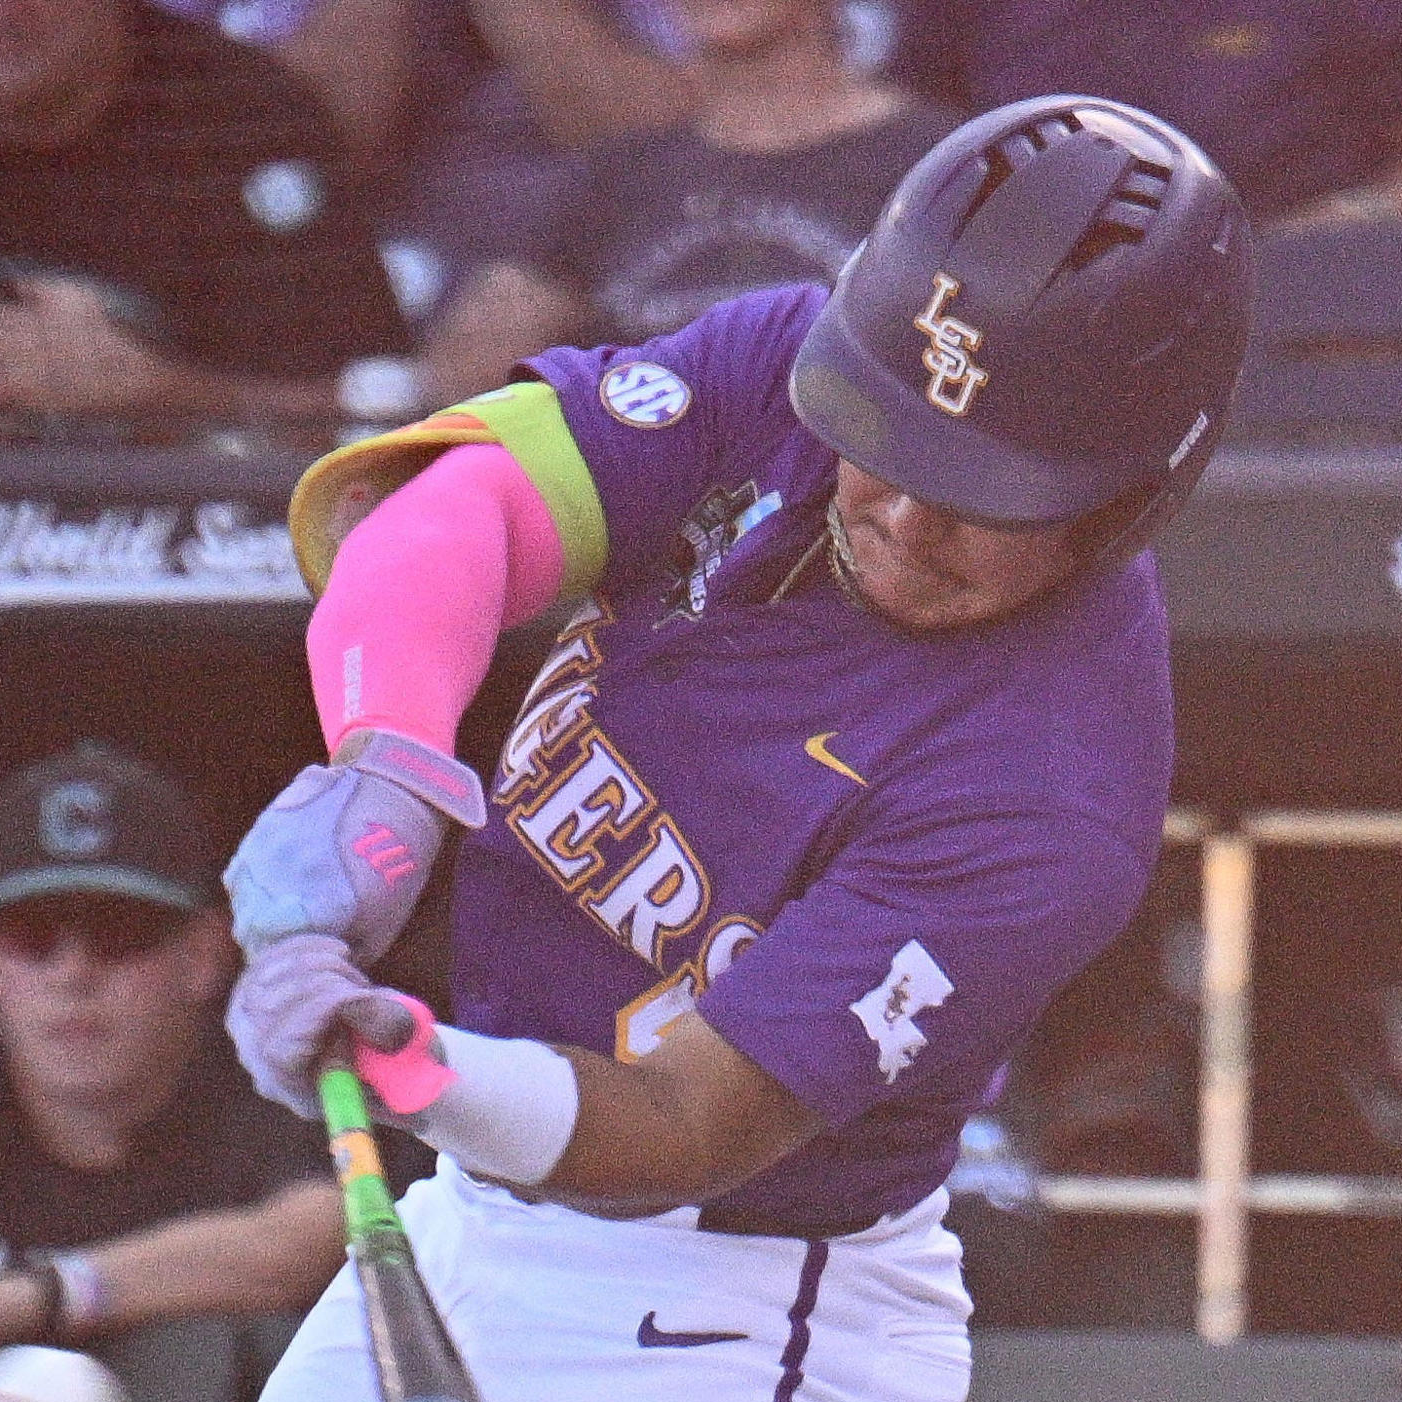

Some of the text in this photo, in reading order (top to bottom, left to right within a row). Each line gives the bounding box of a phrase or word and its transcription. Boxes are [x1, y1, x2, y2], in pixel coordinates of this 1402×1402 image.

[914, 272, 989, 417] LSU
[606, 364, 685, 423] SEC
[180, 500, 297, 582] Ser
[41, 783, 106, 853] C
